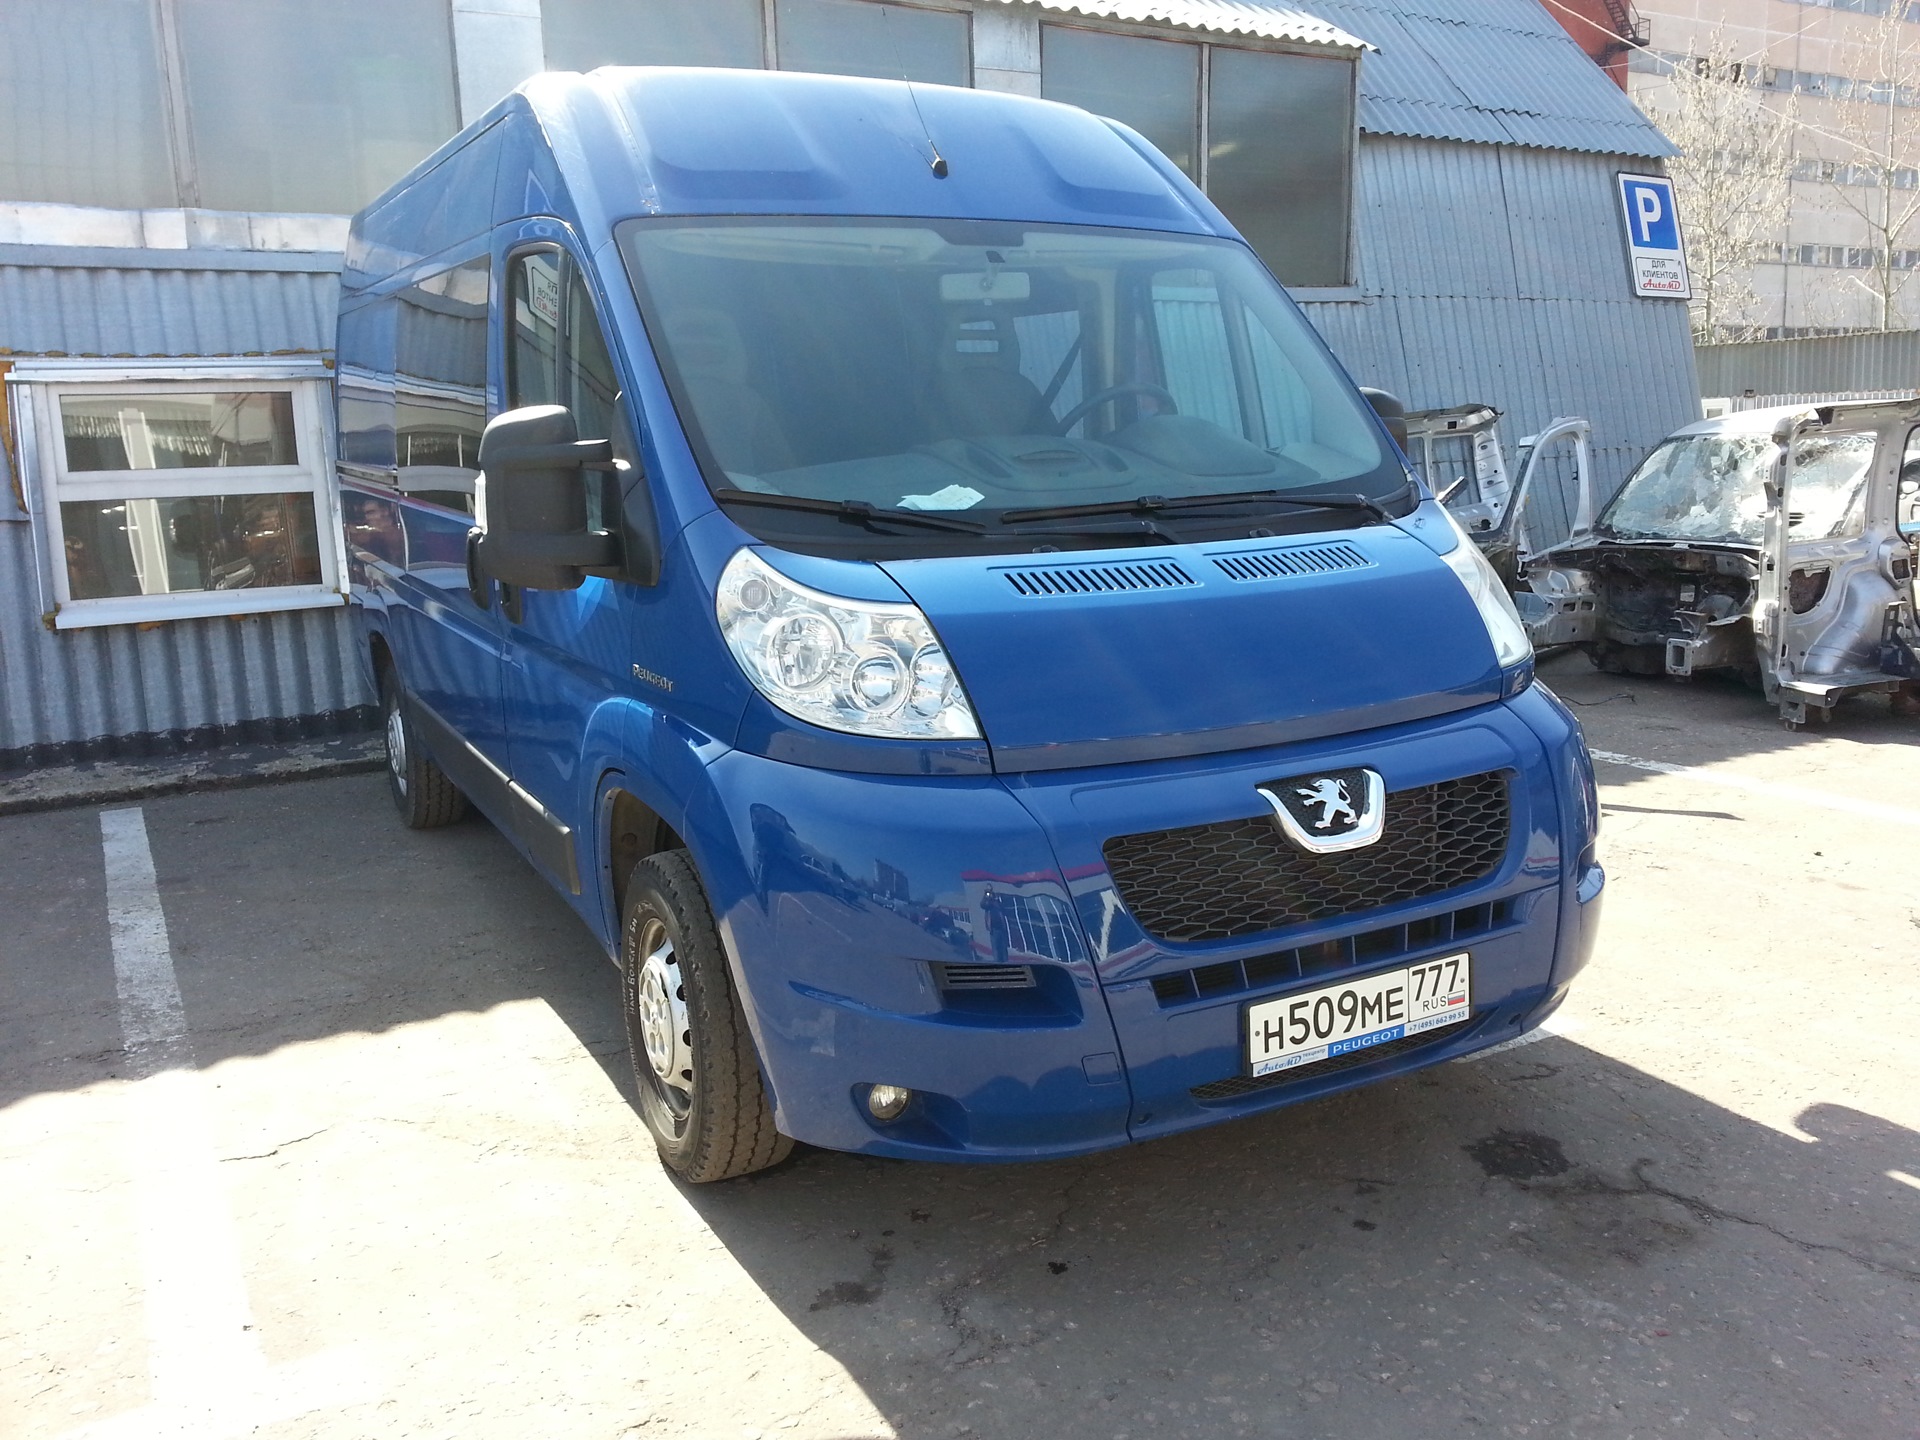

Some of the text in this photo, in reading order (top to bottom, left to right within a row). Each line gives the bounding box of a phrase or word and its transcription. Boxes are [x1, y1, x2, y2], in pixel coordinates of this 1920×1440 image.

[1634, 186, 1662, 242] P
[1642, 269, 1679, 280] КЛИЕНТОВ
[1651, 260, 1666, 269] ДЛЯ
[632, 663, 674, 692] PEUGEOT
[1411, 959, 1460, 1001] 777
[1422, 996, 1447, 1012] RUS
[1418, 1019, 1435, 1030] (495)
[1332, 1028, 1400, 1054] PEUGEOT
